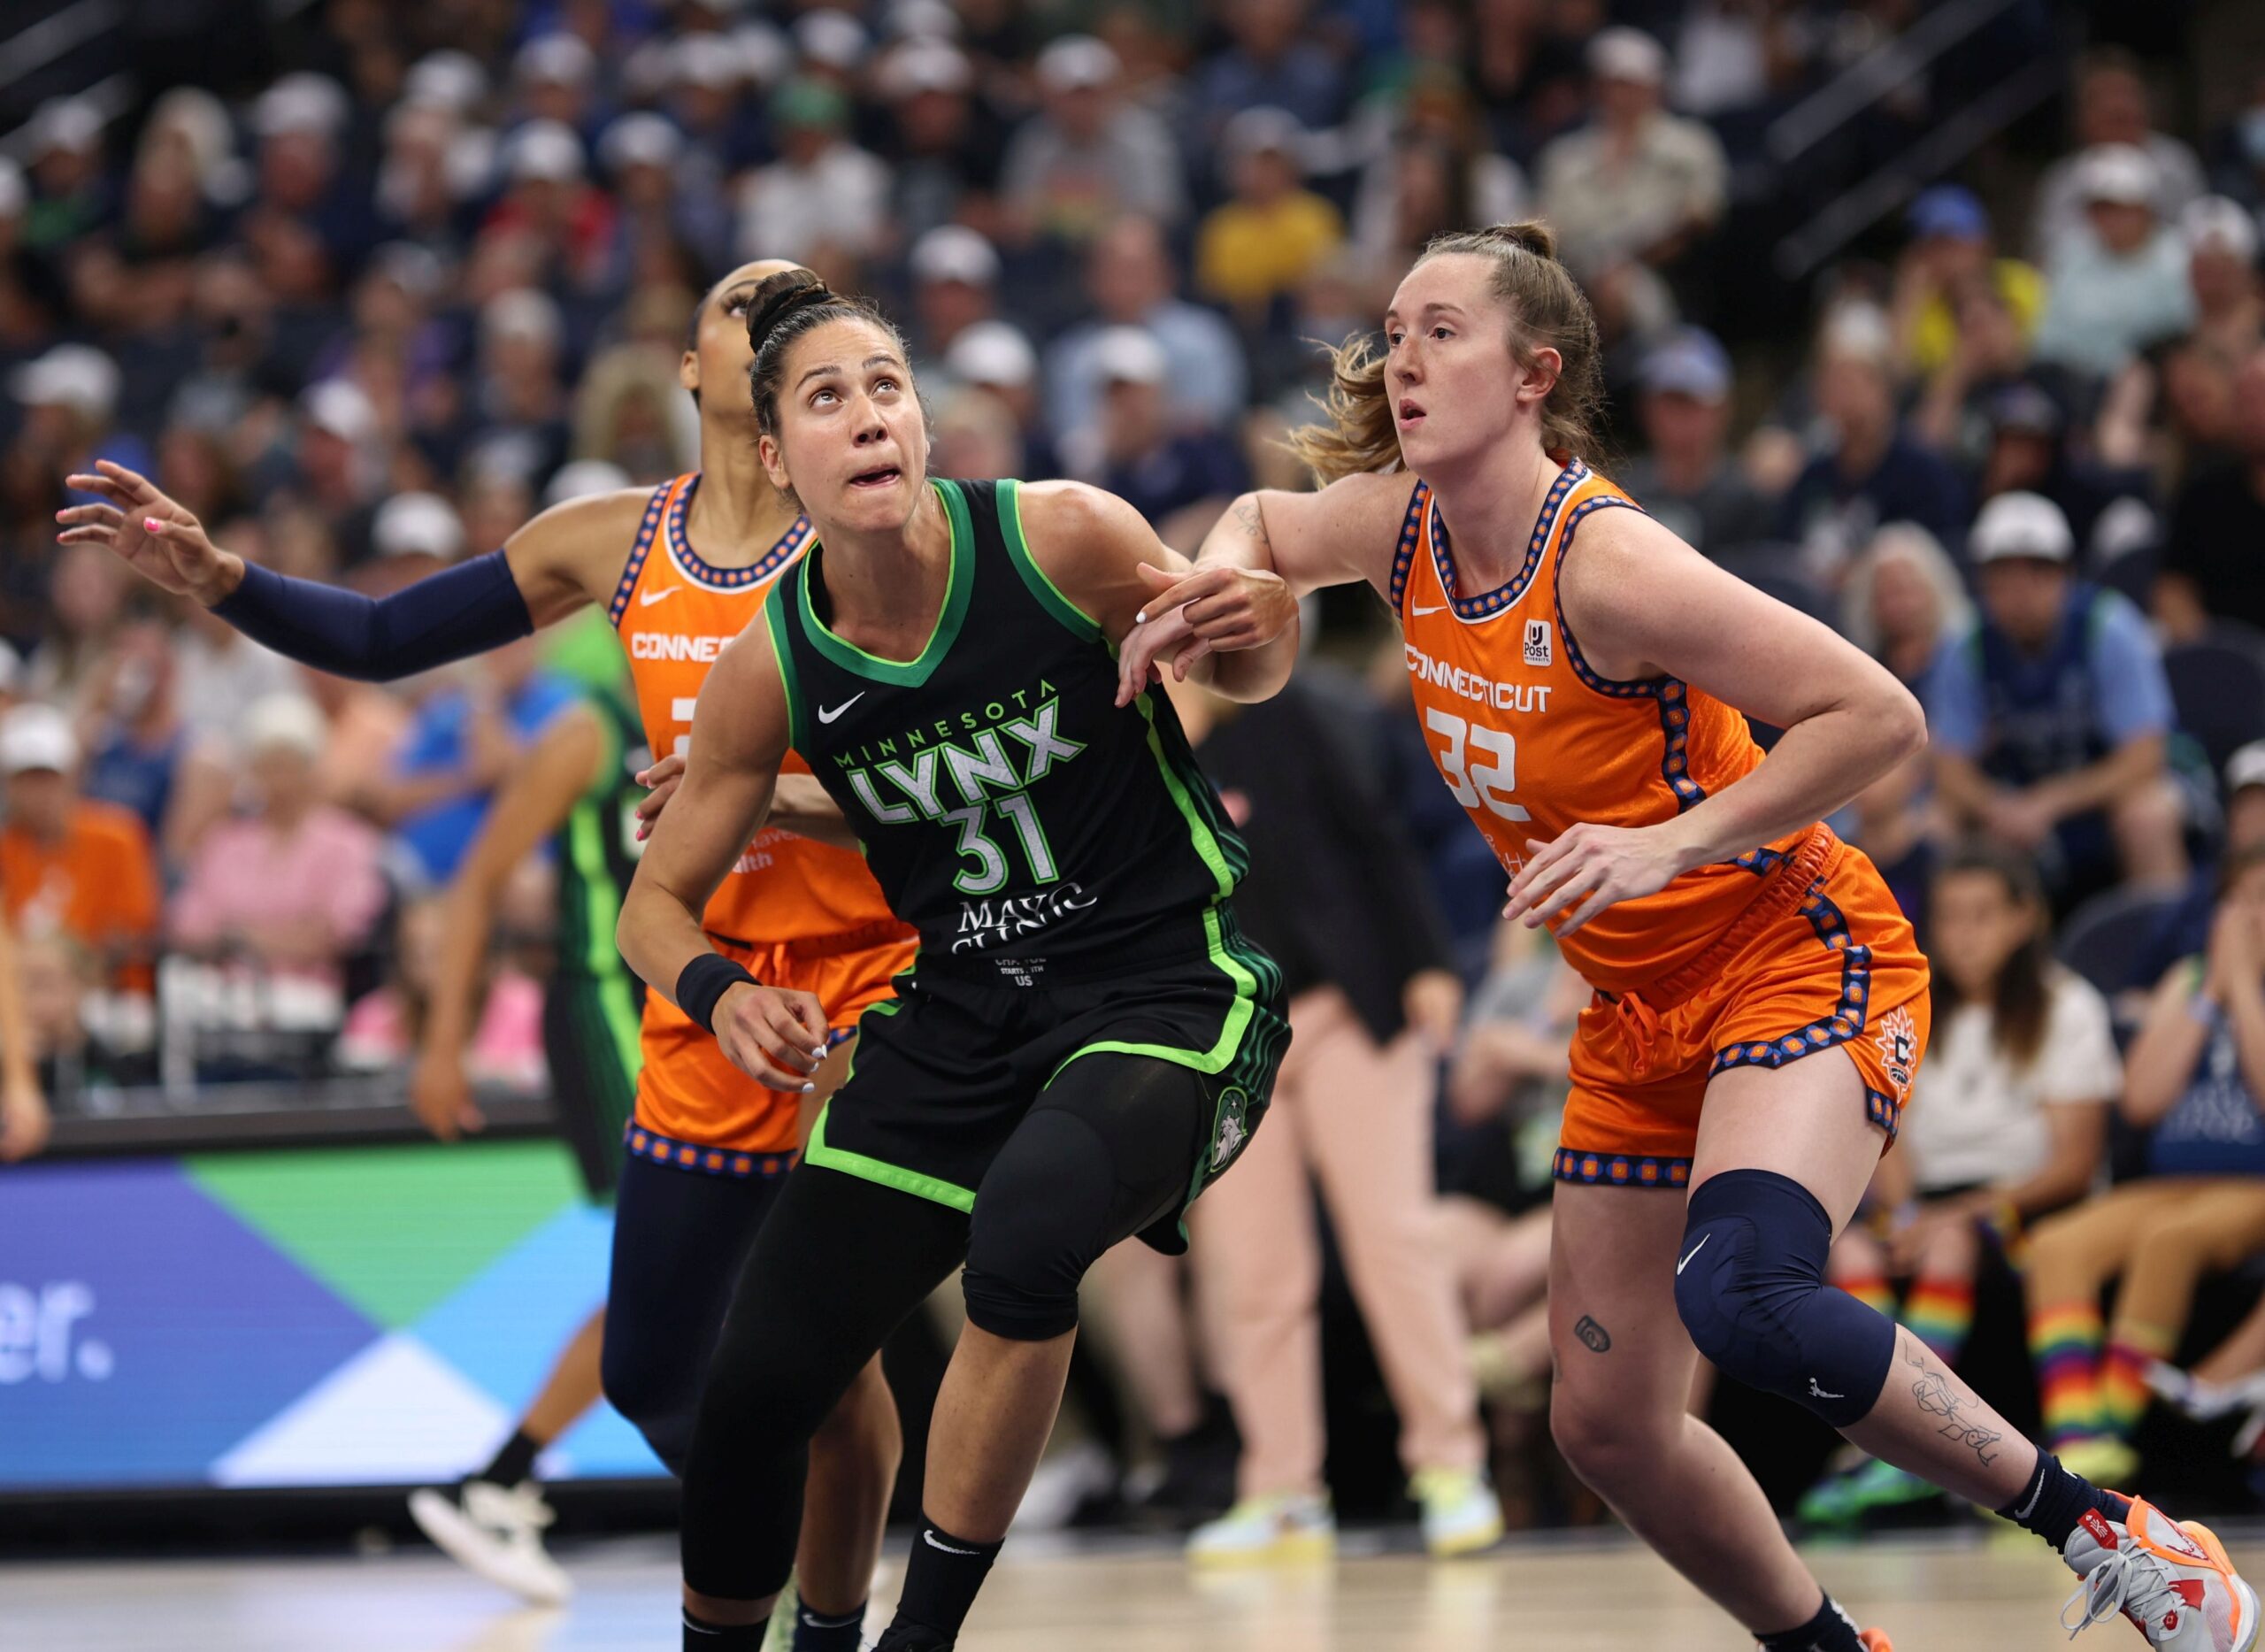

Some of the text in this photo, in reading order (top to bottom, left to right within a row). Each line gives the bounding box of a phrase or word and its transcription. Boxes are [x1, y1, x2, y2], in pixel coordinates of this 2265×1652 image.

[1524, 642, 1549, 657] Post
[833, 679, 1057, 769] MINNESOTA
[846, 695, 1089, 825] LYNX
[1426, 706, 1532, 822] 32
[938, 790, 1060, 895] 31
[1014, 975, 1033, 987] US
